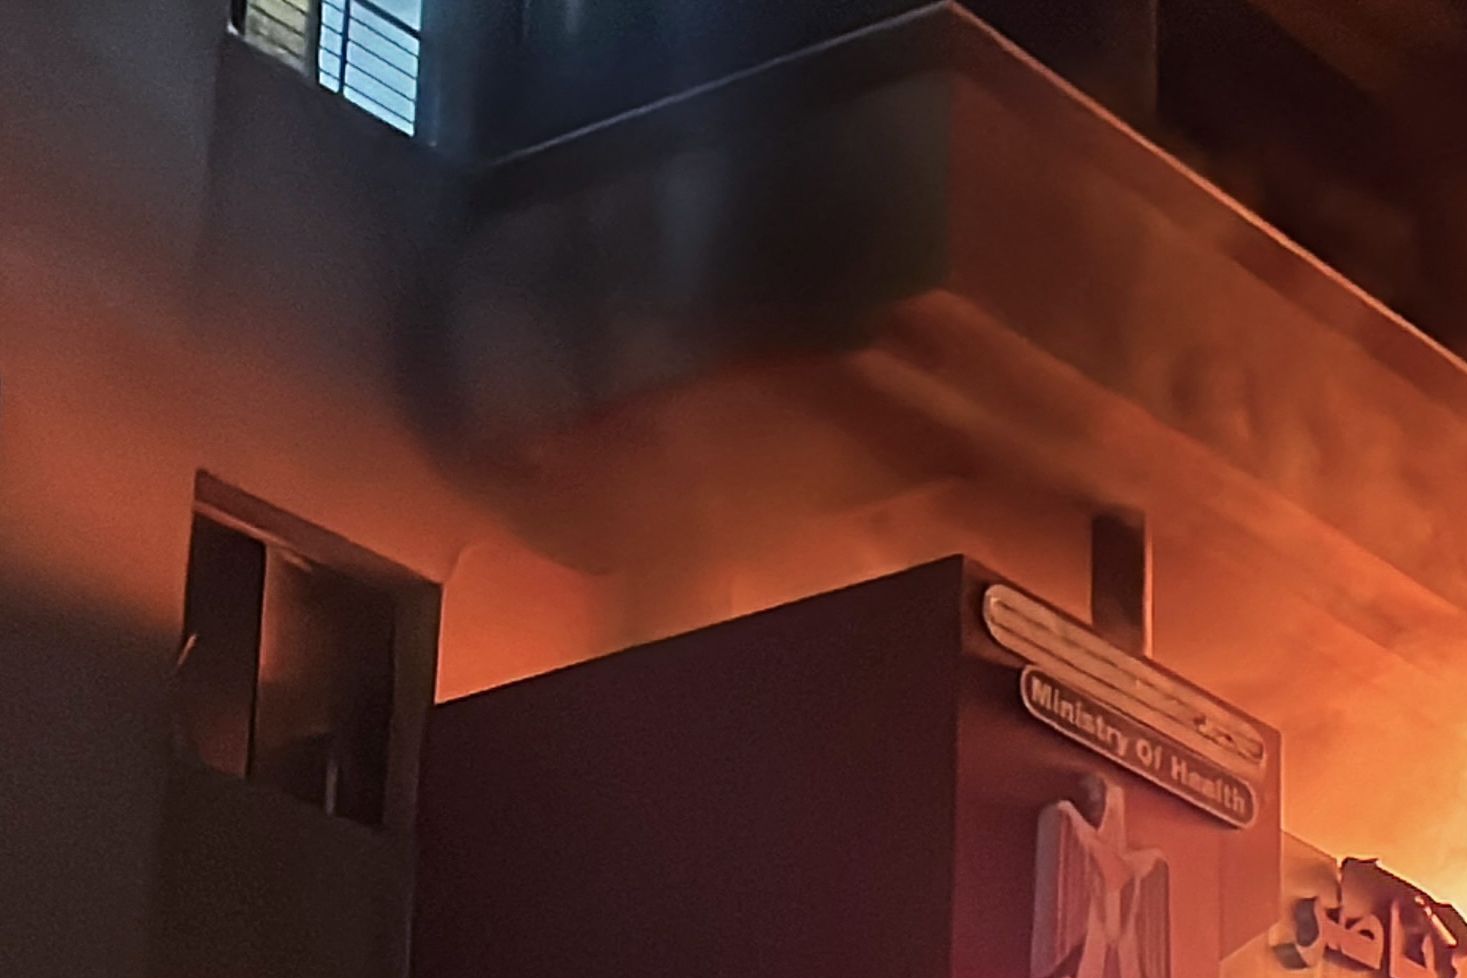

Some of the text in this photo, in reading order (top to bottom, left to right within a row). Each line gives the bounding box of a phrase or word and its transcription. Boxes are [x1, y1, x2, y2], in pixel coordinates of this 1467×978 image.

[1029, 675, 1247, 814] Ministry Of Health
